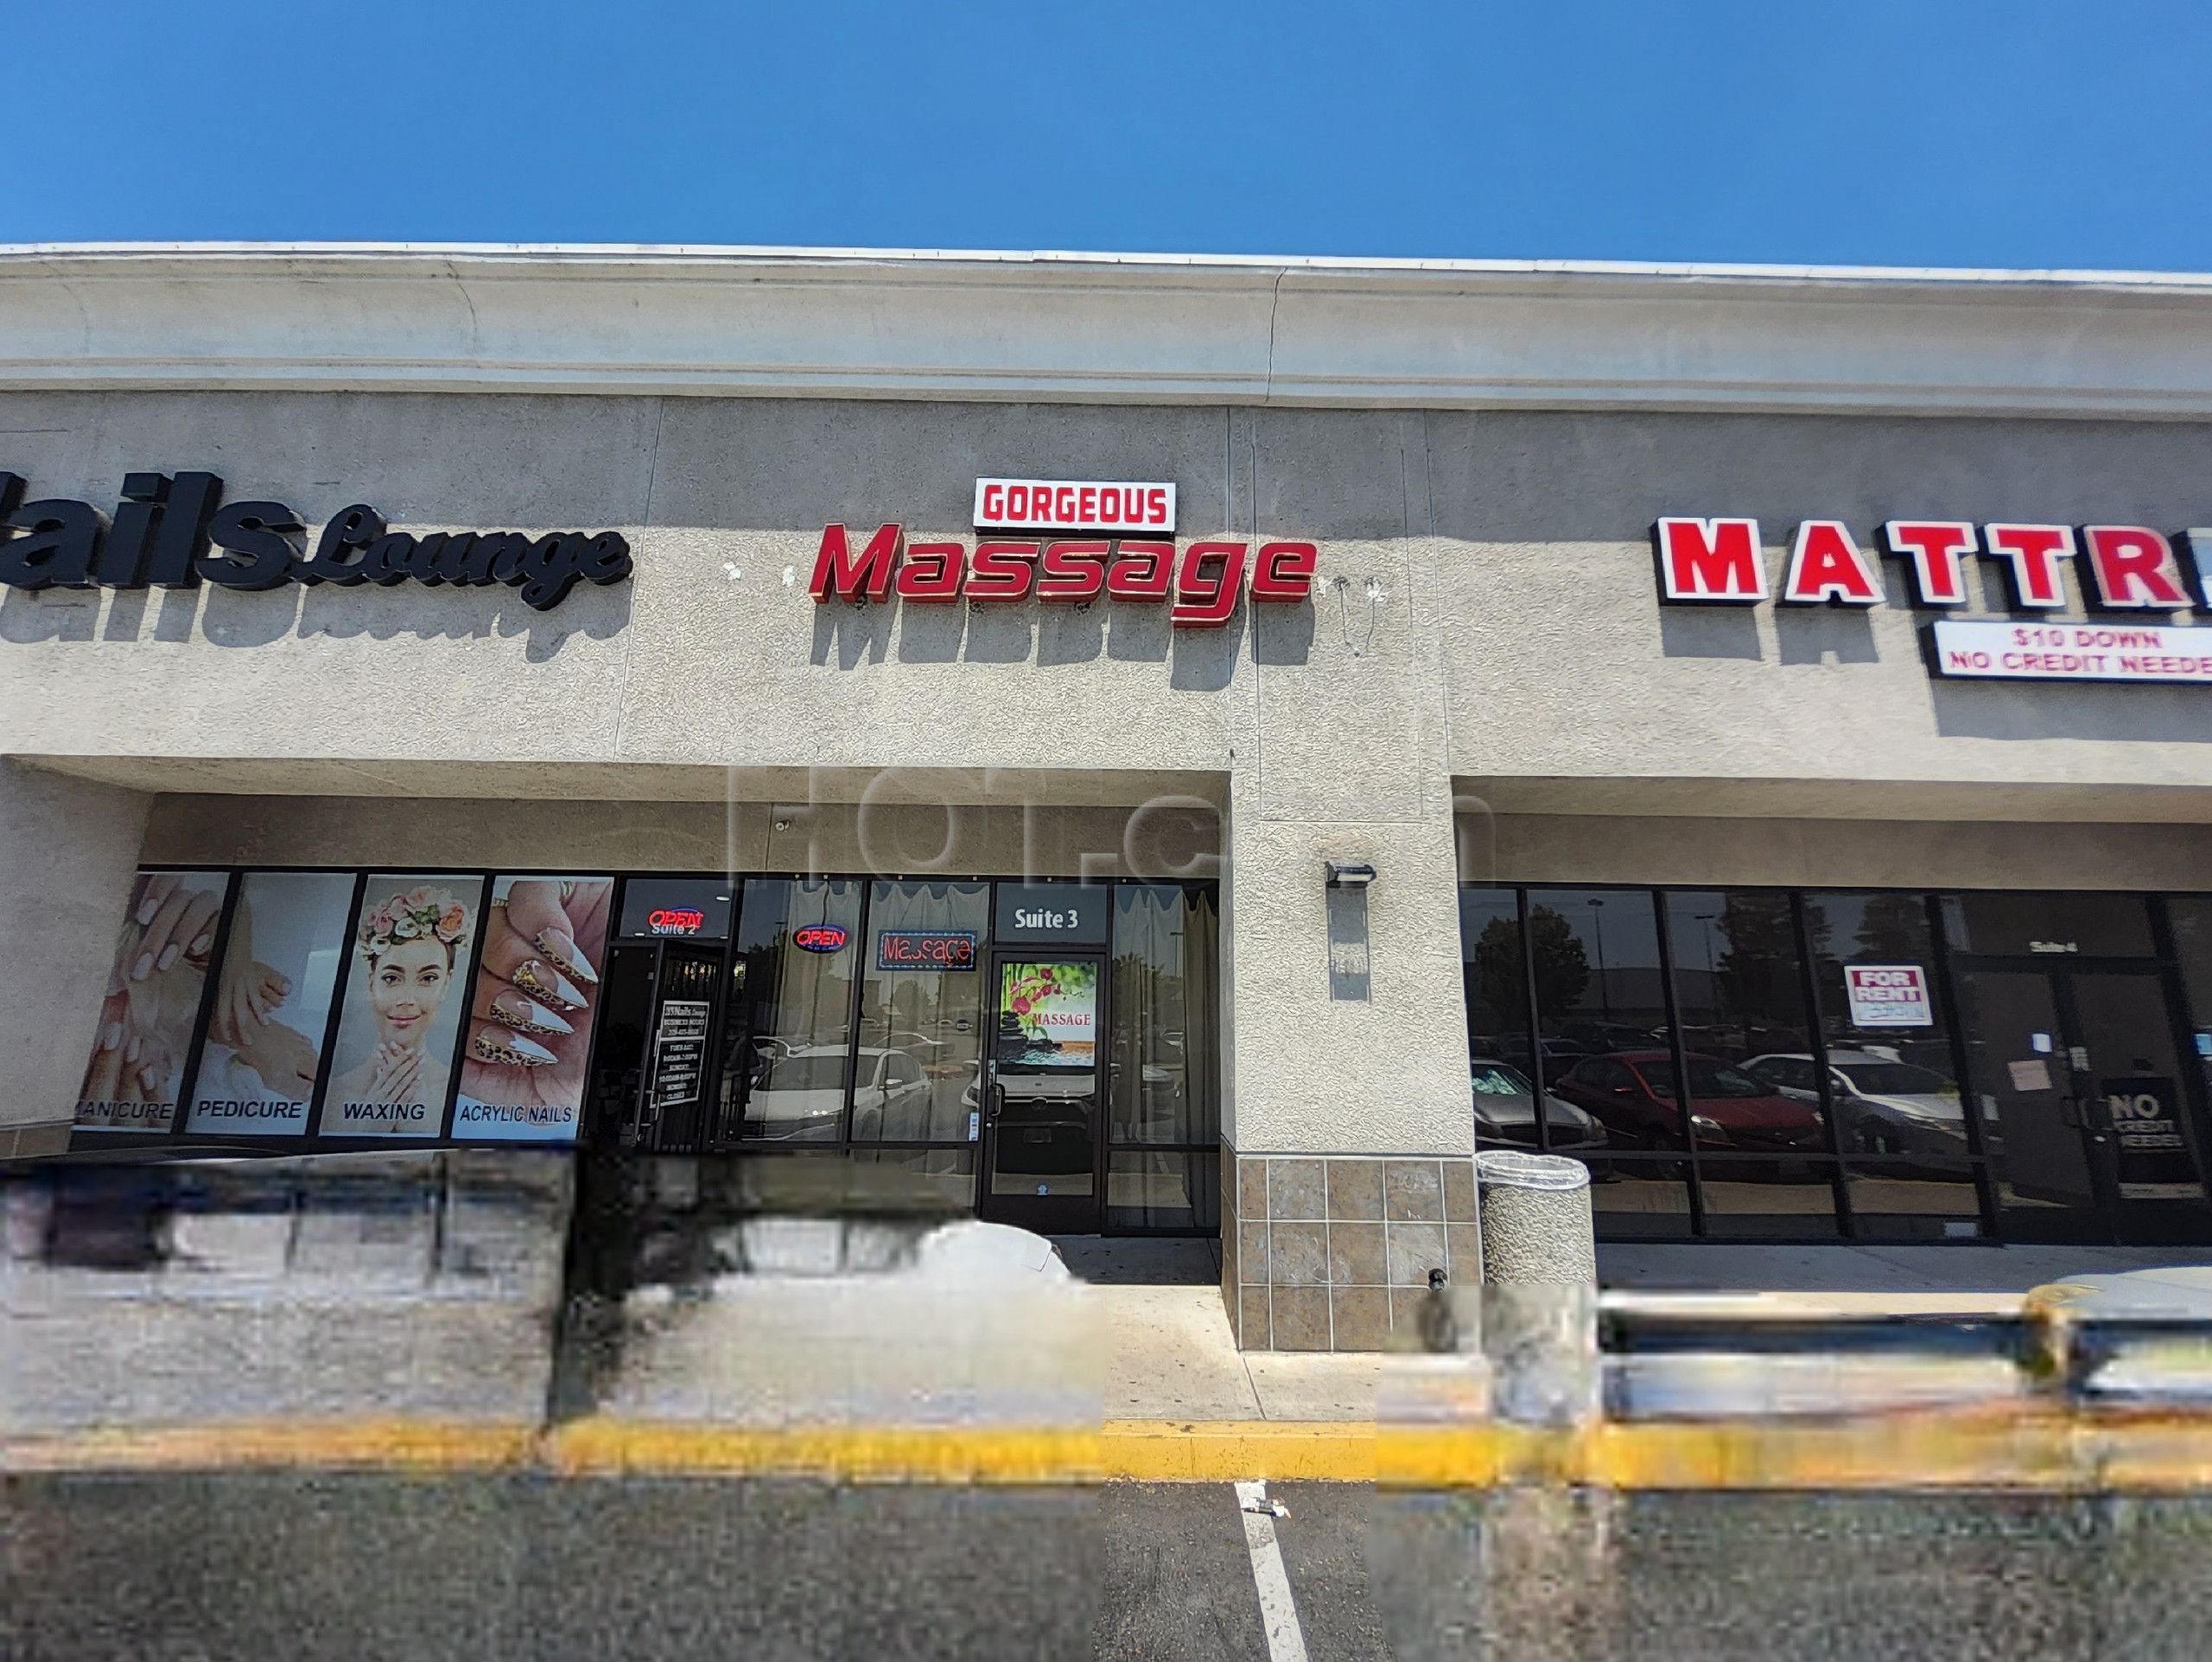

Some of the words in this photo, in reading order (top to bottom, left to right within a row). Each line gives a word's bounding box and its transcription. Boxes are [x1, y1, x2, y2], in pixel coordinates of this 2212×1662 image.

[982, 484, 1167, 525] GORGEOUS
[0, 471, 308, 592] ails
[292, 504, 633, 611] Lounge
[808, 523, 1319, 628] Massage
[2012, 628, 2065, 647] $10
[2075, 630, 2163, 648] DOWN
[1948, 651, 1992, 669] NO
[2001, 652, 2108, 672] CREDIT
[649, 910, 704, 928] OPEN
[1014, 908, 1064, 928] Suite
[1067, 910, 1078, 928] 3
[651, 923, 685, 935] Suite
[797, 930, 845, 946] OPEN
[1859, 971, 1910, 986] FOR
[1855, 986, 1921, 1002] RENT
[1033, 1013, 1090, 1026] MASSAGE
[197, 1100, 302, 1119] PEDICURE
[344, 1102, 425, 1121] WAXING
[460, 1105, 524, 1122] ACRYLIC
[528, 1105, 572, 1123] NAILS
[2108, 1093, 2160, 1119] NO
